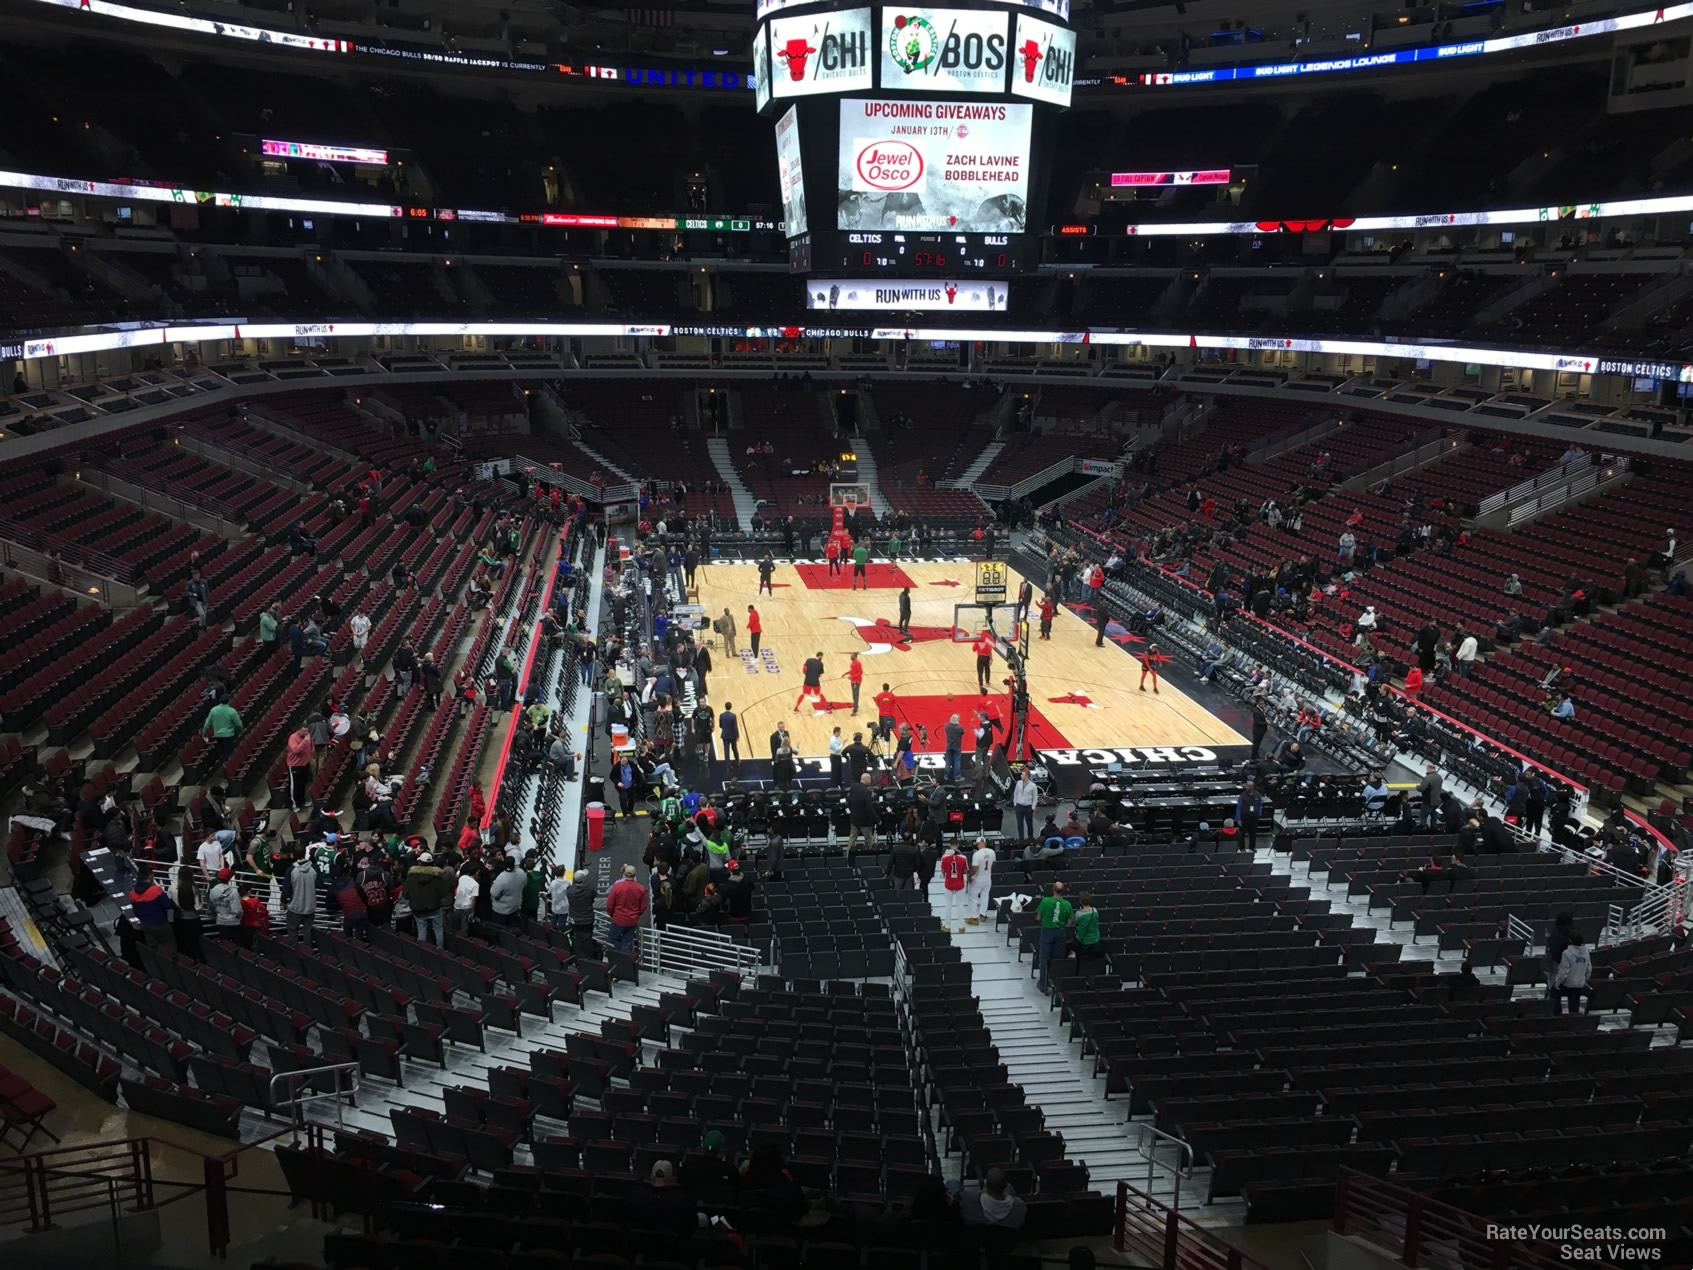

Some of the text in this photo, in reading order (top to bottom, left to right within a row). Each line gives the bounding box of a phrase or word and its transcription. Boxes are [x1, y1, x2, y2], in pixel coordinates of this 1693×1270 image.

[925, 24, 938, 57] CELTICS
[1438, 43, 1483, 56] BUD LIGHT
[355, 45, 368, 53] THE
[369, 47, 400, 57] CHICAGO
[401, 51, 422, 59] BULLS
[423, 53, 443, 61] 50/50
[444, 56, 468, 65] RAFFLE
[469, 59, 500, 67] JACKPOT
[509, 62, 546, 71] CURRENTLY
[1256, 54, 1396, 76] BUD LIGHT LEGENDS LOUNGE
[625, 67, 739, 89] UNITED
[1173, 72, 1214, 82] BUD LIGHT
[865, 102, 1006, 121] UPCOMING GIVEAWAYS
[891, 125, 927, 135] JANUARY
[866, 149, 913, 166] Jewel
[946, 154, 1019, 167] ZACH LAVINE
[868, 165, 910, 181] Osco
[944, 170, 1019, 182] BOBBLEHEAD
[410, 208, 427, 217] 6:05
[545, 214, 577, 223] Budweiser
[686, 219, 707, 229] CELTICS
[1061, 226, 1087, 234] ASSISTS
[849, 234, 882, 244] CELTICS
[984, 236, 1008, 245] BULLS
[899, 246, 905, 255] 0
[960, 247, 966, 256] 0
[863, 252, 872, 265] 0
[998, 254, 1006, 267] 0
[876, 288, 941, 303] RUN WITH US
[295, 325, 308, 335] RUN
[321, 324, 328, 333] US
[706, 327, 738, 335] CELTICS
[767, 328, 778, 336] VS
[806, 329, 841, 337] CHICAGO
[1248, 338, 1262, 348] RUN
[1, 344, 22, 358] BULLS
[1600, 361, 1671, 376] BOSTON CELTICS
[950, 861, 957, 875] 1
[597, 856, 611, 895] CENTER
